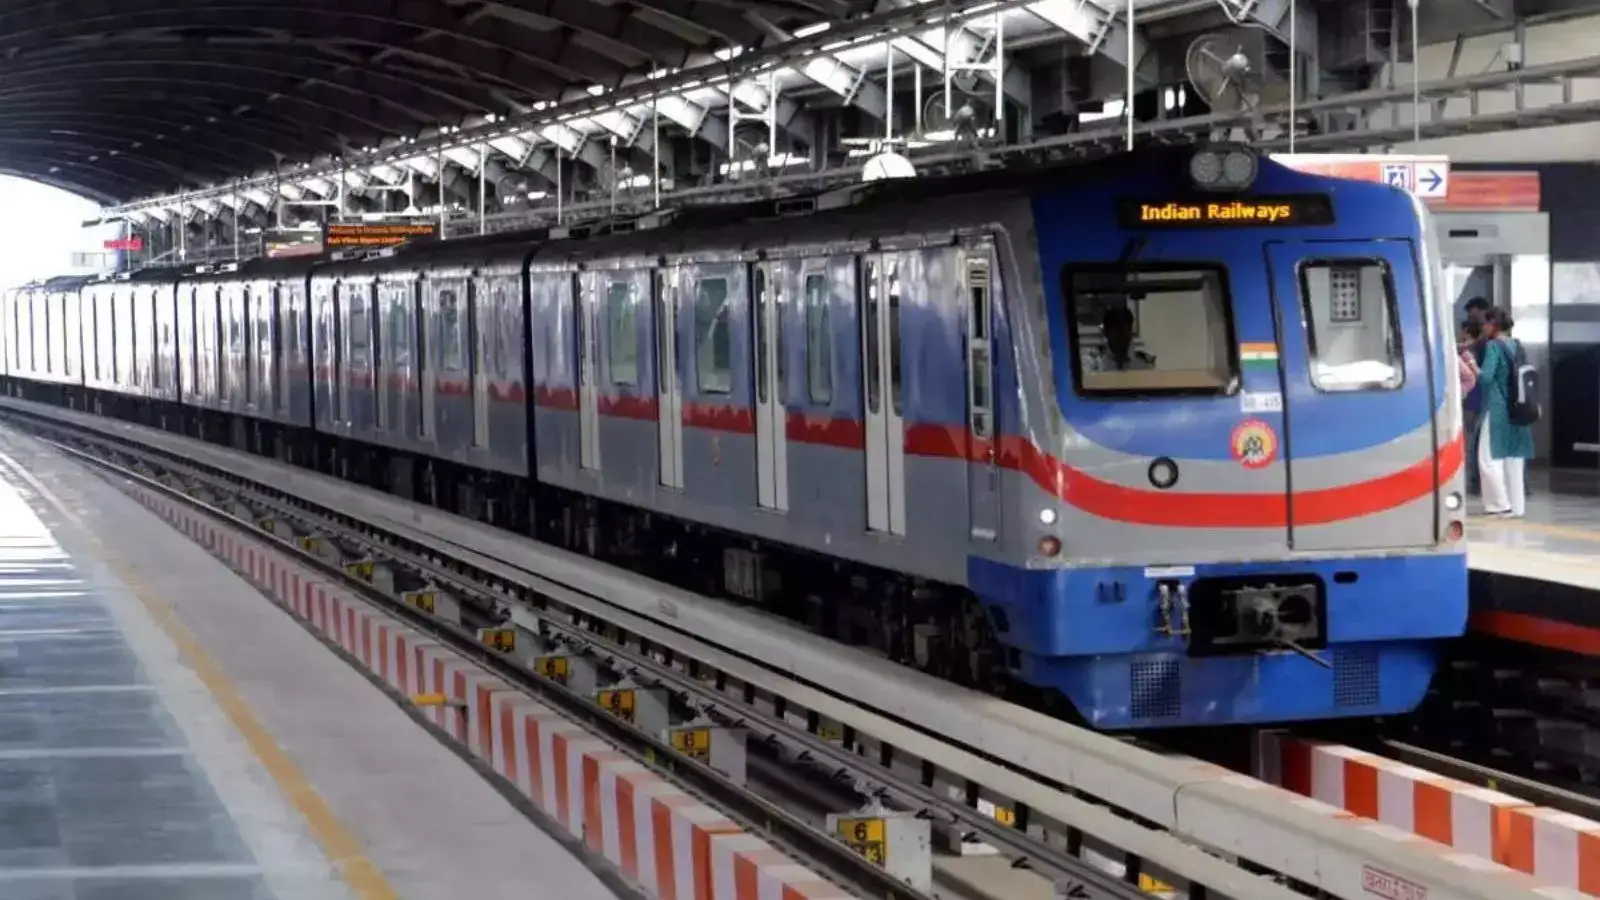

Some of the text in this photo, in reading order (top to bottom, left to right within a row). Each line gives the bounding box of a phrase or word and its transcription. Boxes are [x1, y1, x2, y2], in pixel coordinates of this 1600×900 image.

[1141, 202, 1290, 222] Indian Railways
[854, 821, 867, 841] 6
